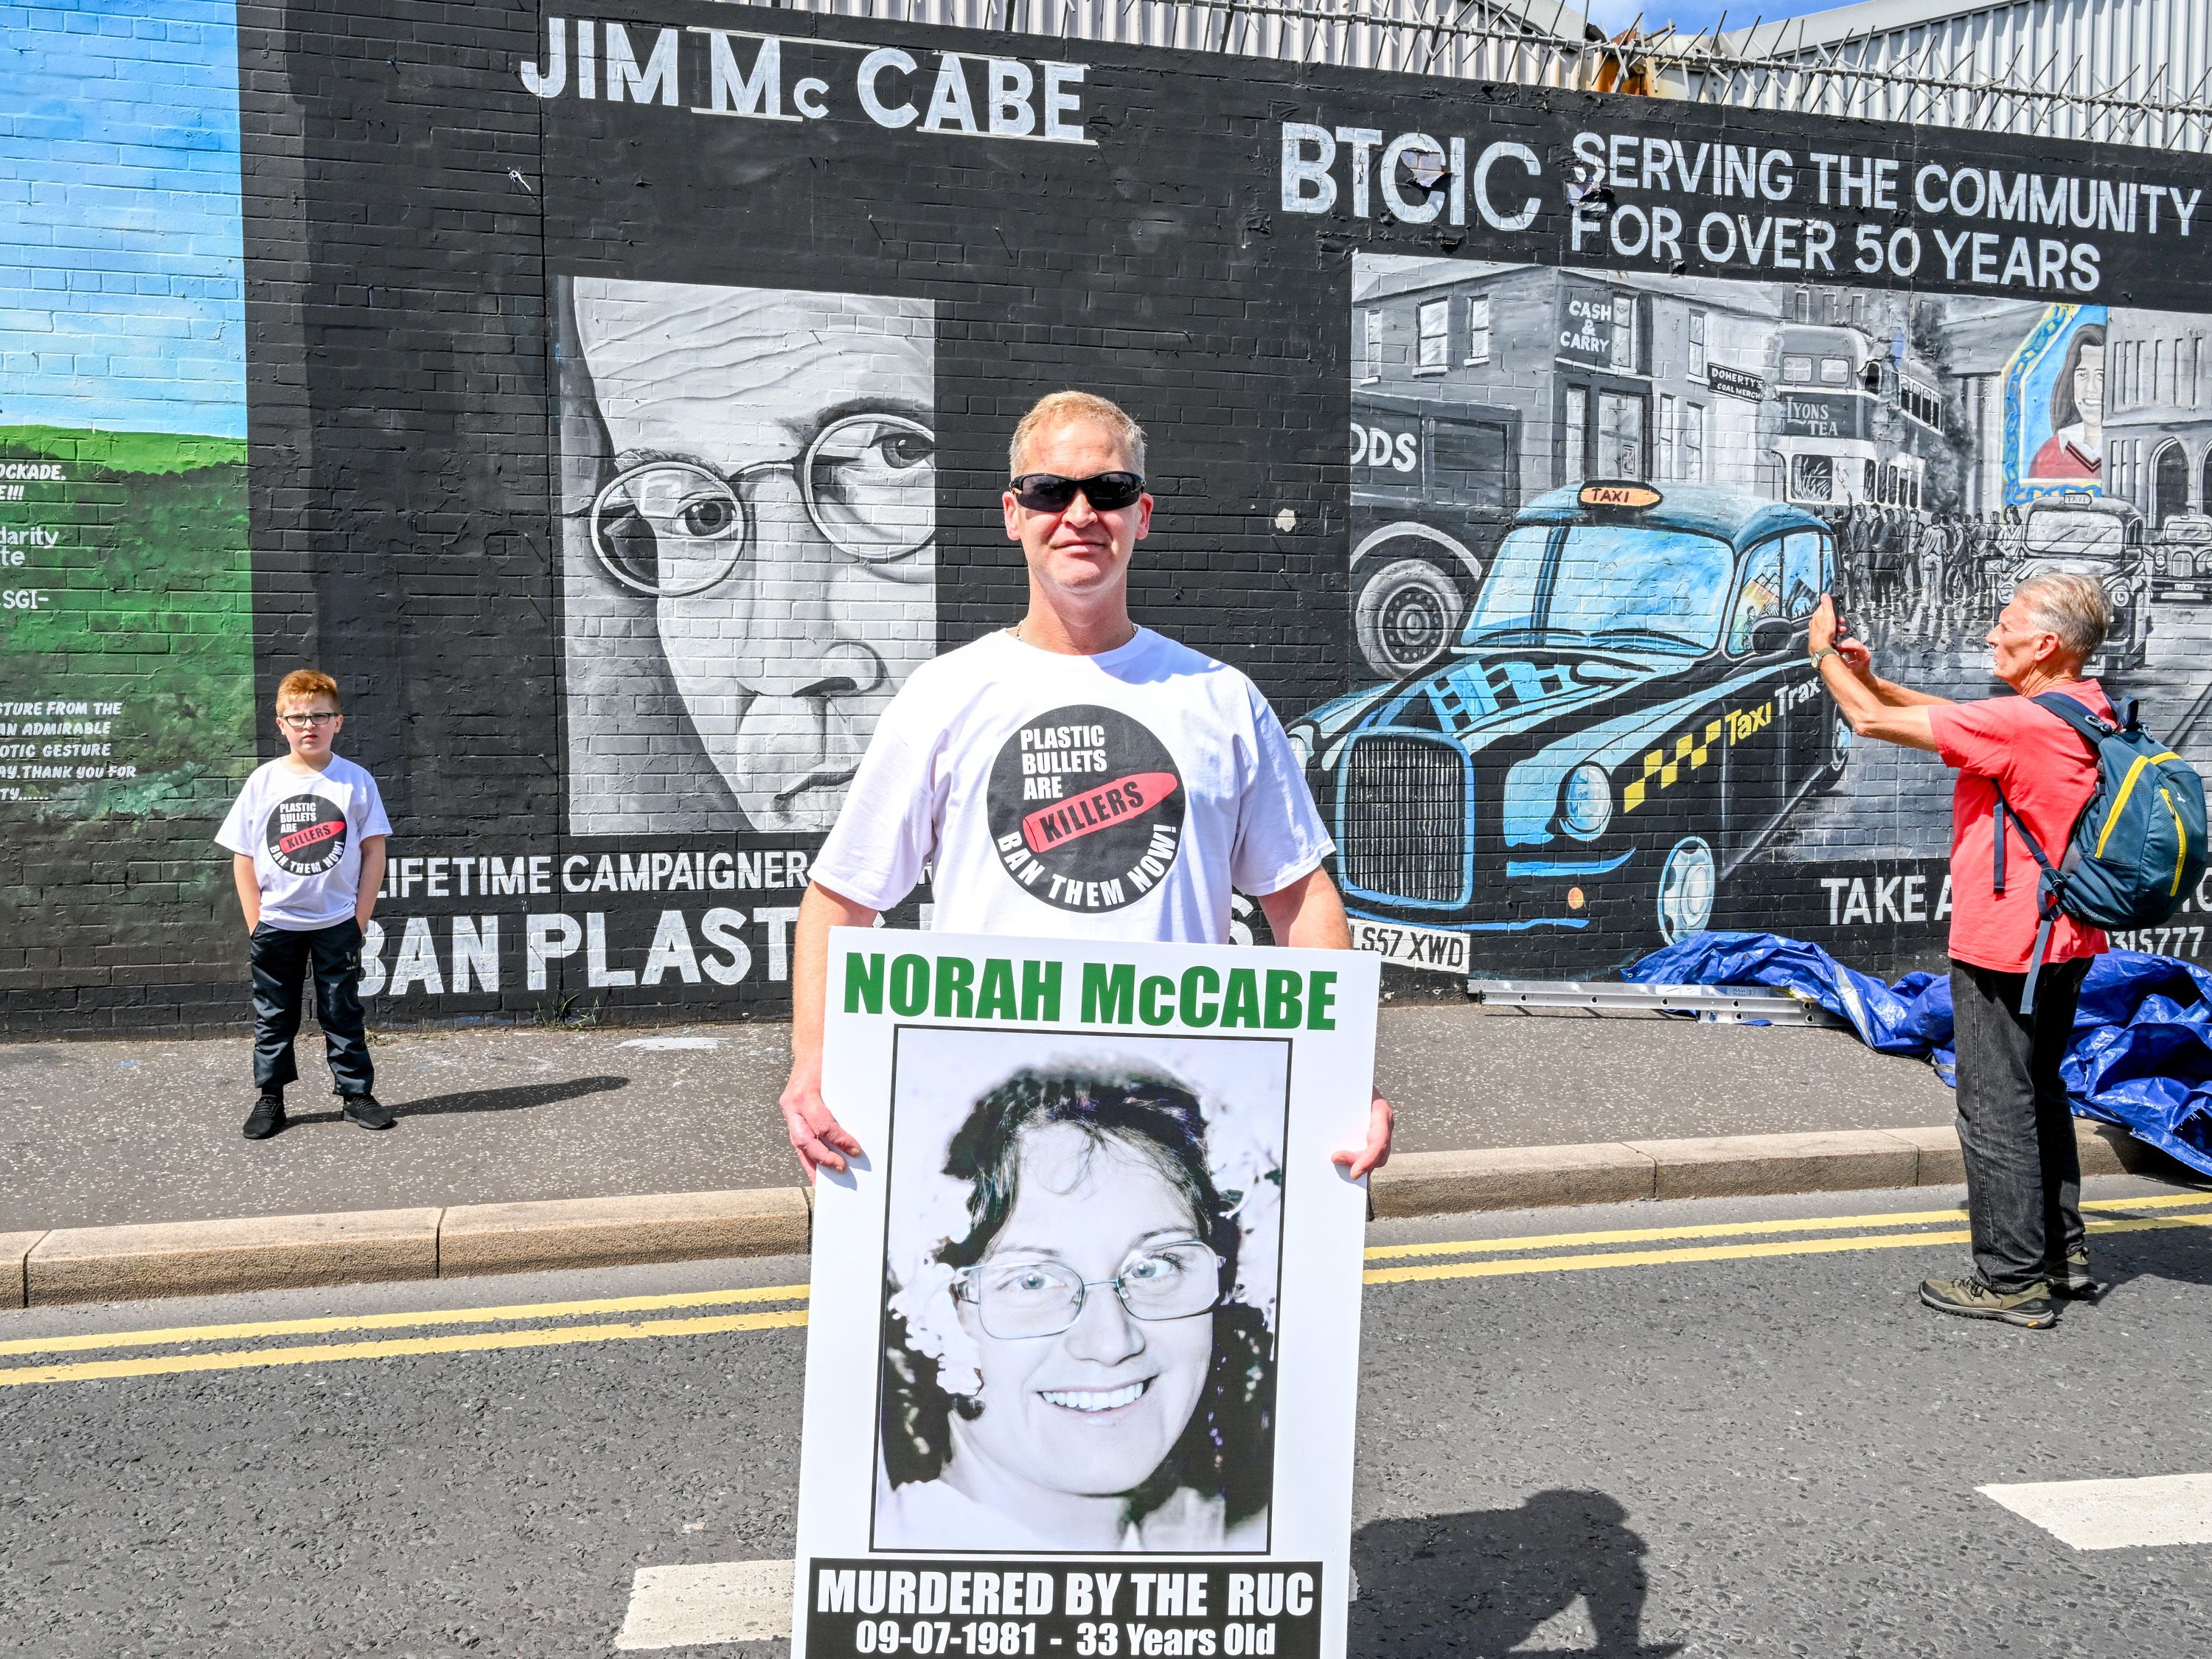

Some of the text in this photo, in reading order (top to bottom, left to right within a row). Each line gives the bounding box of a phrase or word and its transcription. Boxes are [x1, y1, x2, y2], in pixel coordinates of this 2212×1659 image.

[521, 17, 1085, 142] JIM Mc CABE
[1281, 122, 1541, 231] BTCIC
[1572, 132, 2202, 236] SERVING THE COMMUNITY
[1572, 203, 2100, 291] FOR OVER 50 YEARS
[1569, 300, 1612, 321] CASH
[1582, 319, 1596, 336] &
[1560, 331, 1610, 353] CARRY
[1711, 368, 1763, 389] DOHERTY'S
[1717, 383, 1735, 394] COAL
[1786, 396, 1829, 425] LYONS
[1807, 420, 1838, 437] TEA
[1591, 488, 1630, 503] TAXI
[0, 702, 123, 716] TURE FROM THE
[1775, 676, 1821, 716] Trax
[22, 721, 111, 736] ADMIRABLE
[1020, 725, 1105, 751] PLASTIC
[42, 743, 111, 758] GESTURE
[1021, 749, 1107, 775] BULLETS
[76, 766, 104, 779] YOU
[108, 765, 136, 779] FOR
[1023, 776, 1063, 801] ARE
[279, 802, 316, 813] PLASTIC
[280, 812, 317, 824] BULLETS
[1039, 782, 1144, 844] KILLERS
[280, 823, 298, 833] ARE
[286, 825, 331, 849] KILLERS
[269, 841, 344, 874] BAN THEM NOW!
[997, 830, 1046, 886] BAN
[1048, 873, 1125, 907] THEM
[1127, 824, 1177, 893] NOW!
[563, 850, 810, 893] CAMPAIGNER
[1820, 874, 1927, 925] TAKE
[357, 915, 499, 996] BAN
[1407, 931, 1464, 967] XWD
[844, 951, 1338, 1030] NORAH McCABE
[817, 1569, 1314, 1615] MURDERED BY THE RUC
[855, 1621, 1036, 1655] 09-07-1981
[1076, 1622, 1119, 1655] 33
[1127, 1624, 1217, 1657] Years
[1223, 1622, 1275, 1655] Old
